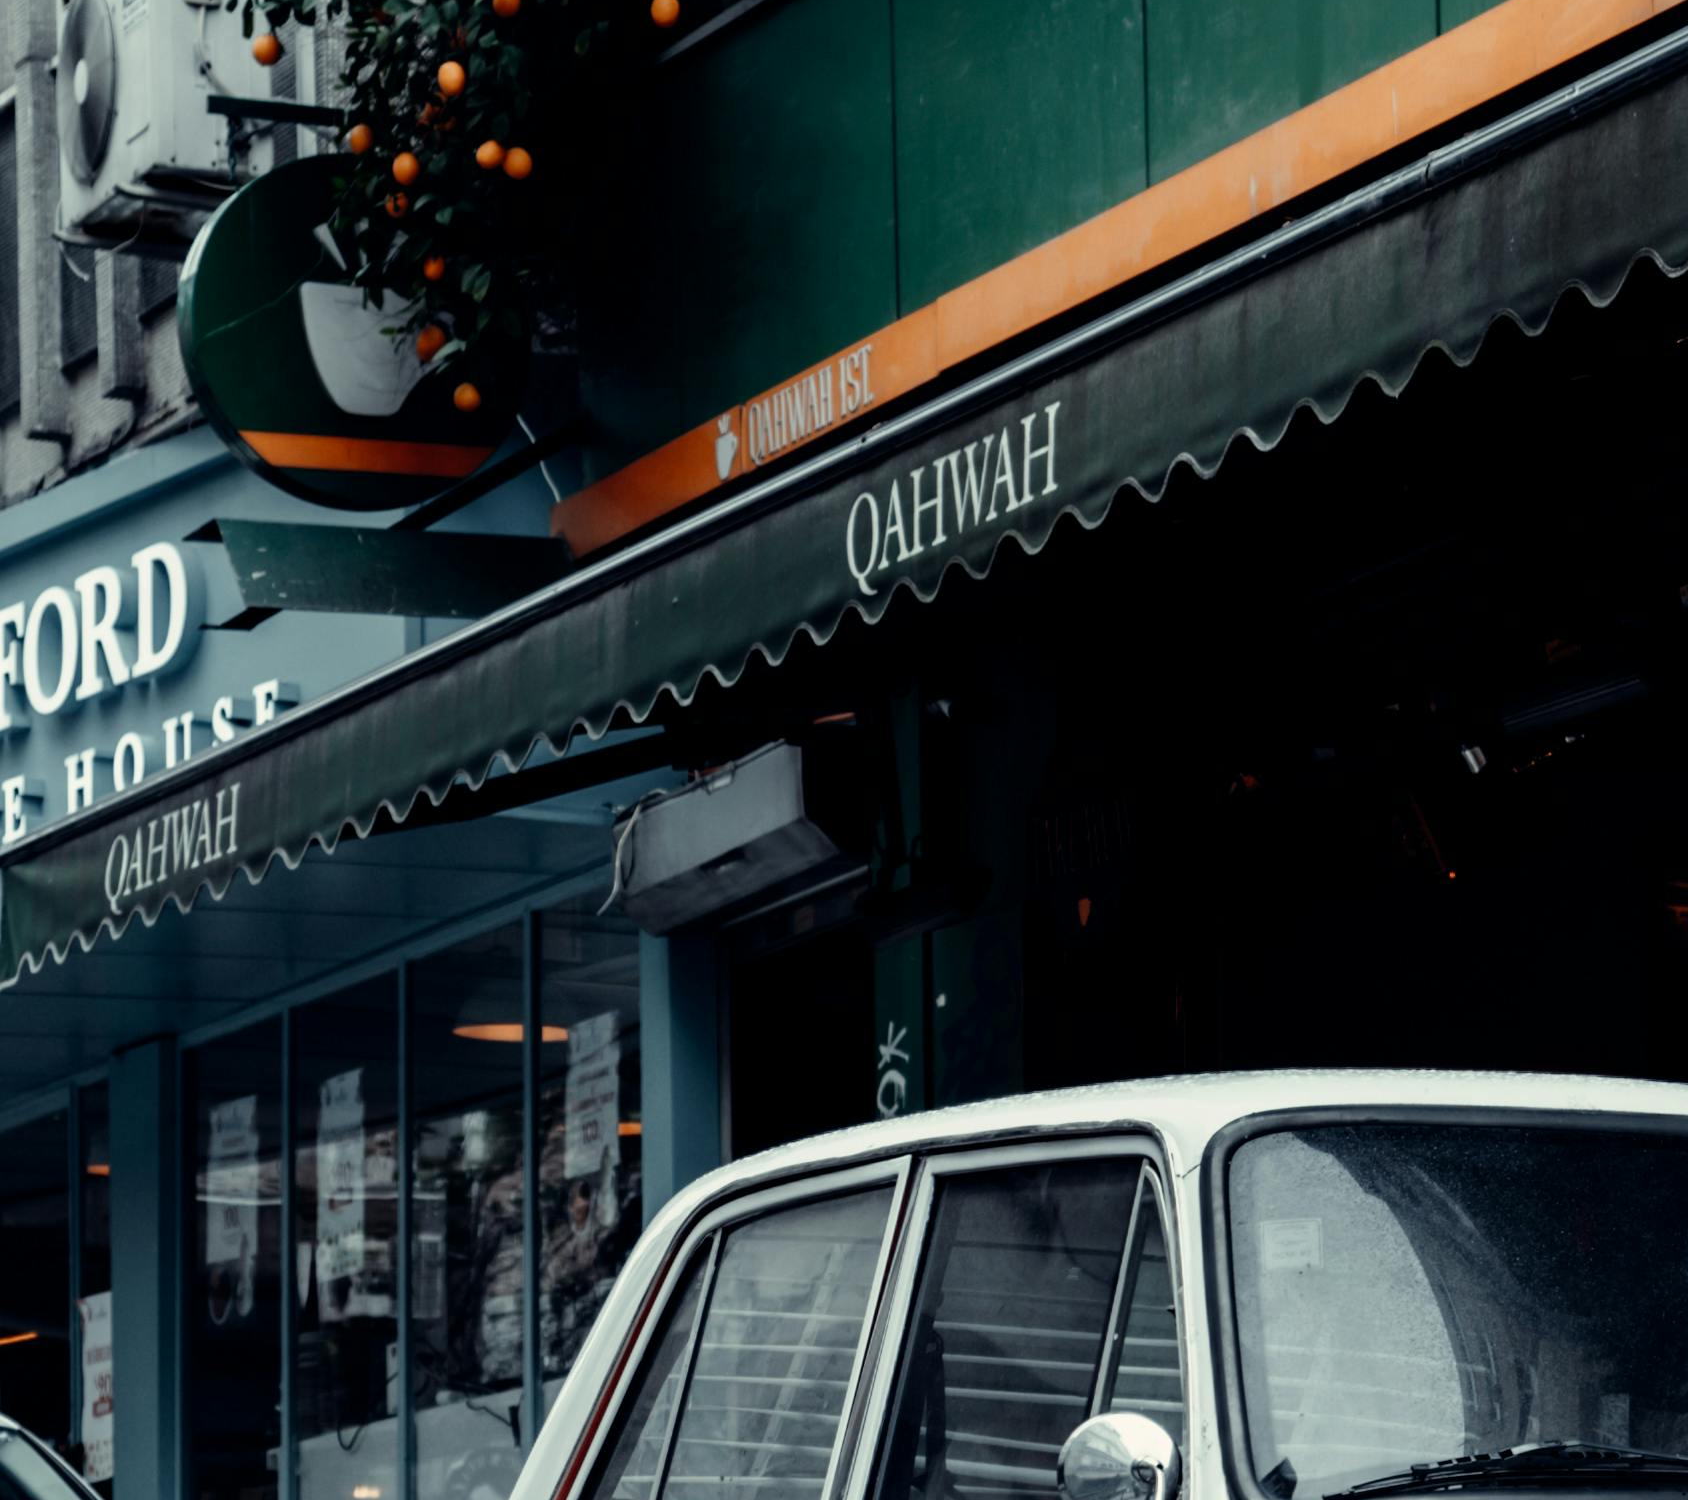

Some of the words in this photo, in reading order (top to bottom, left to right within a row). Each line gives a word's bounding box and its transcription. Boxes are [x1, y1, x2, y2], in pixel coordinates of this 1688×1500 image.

[748, 365, 834, 466] QAHWAH
[846, 401, 1061, 596] QAHWAH
[64, 679, 279, 816] HOUSE
[104, 781, 240, 915] QAHWAH
